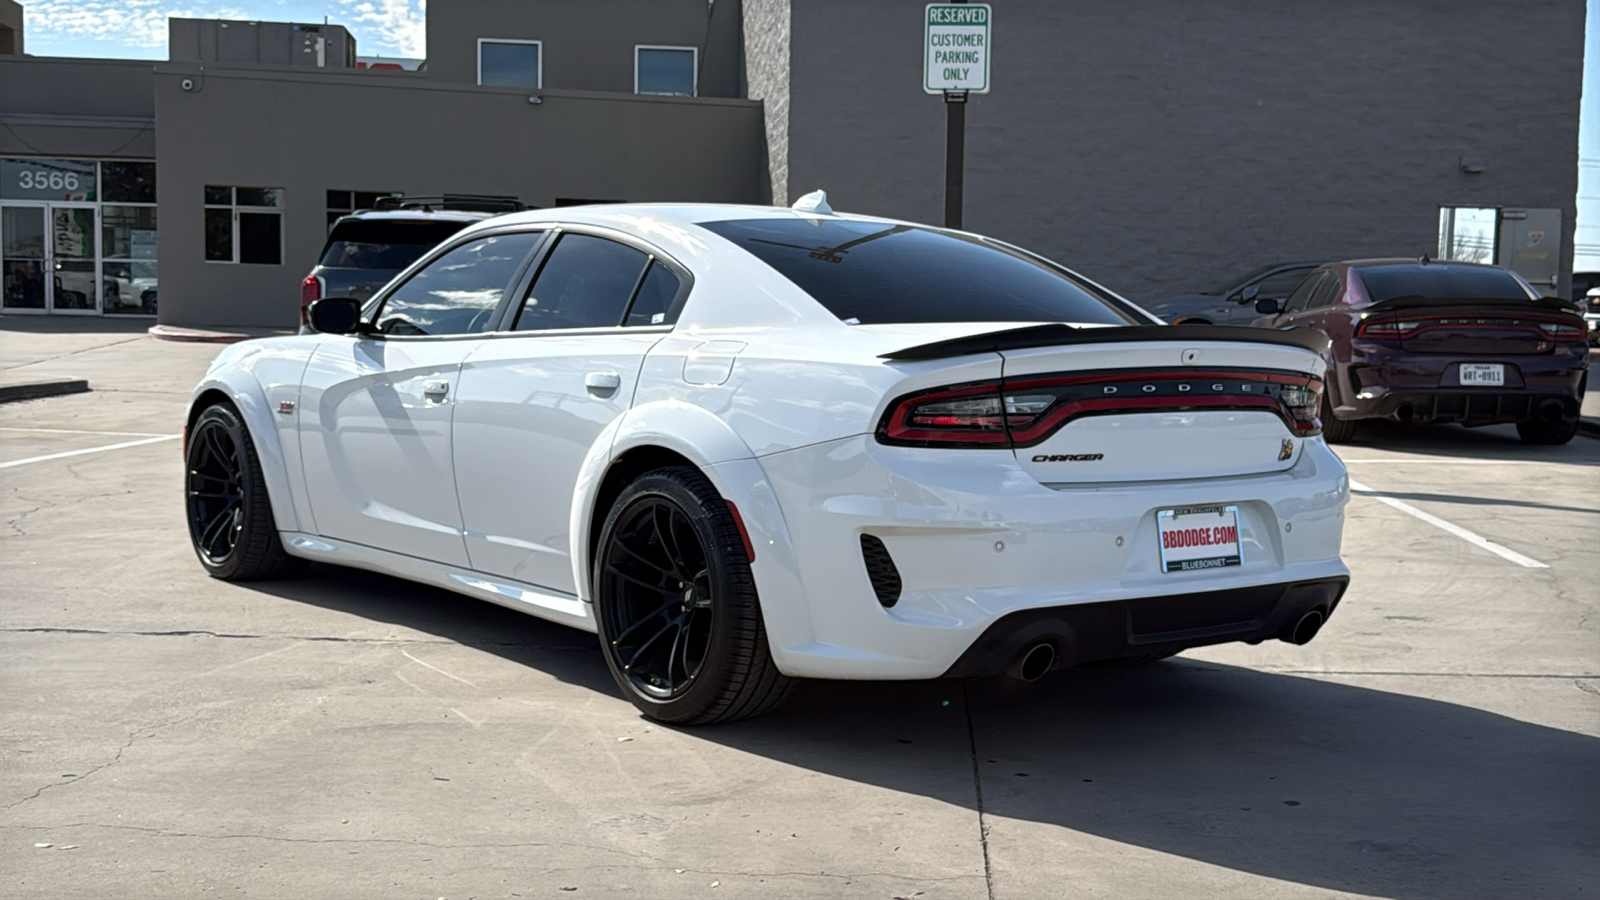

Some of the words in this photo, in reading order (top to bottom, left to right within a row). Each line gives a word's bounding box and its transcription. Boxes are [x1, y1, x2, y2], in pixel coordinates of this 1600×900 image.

[929, 7, 987, 23] RESERVED
[931, 33, 984, 47] CUSTOMER
[934, 51, 979, 64] PARKING
[943, 68, 970, 81] ONLY
[19, 170, 79, 190] 3566
[1103, 383, 1252, 394] DODGE
[1031, 453, 1104, 463] CHARGER
[1162, 525, 1237, 549] BBDODGE.COM
[1181, 557, 1226, 570] BLUEBONNET
